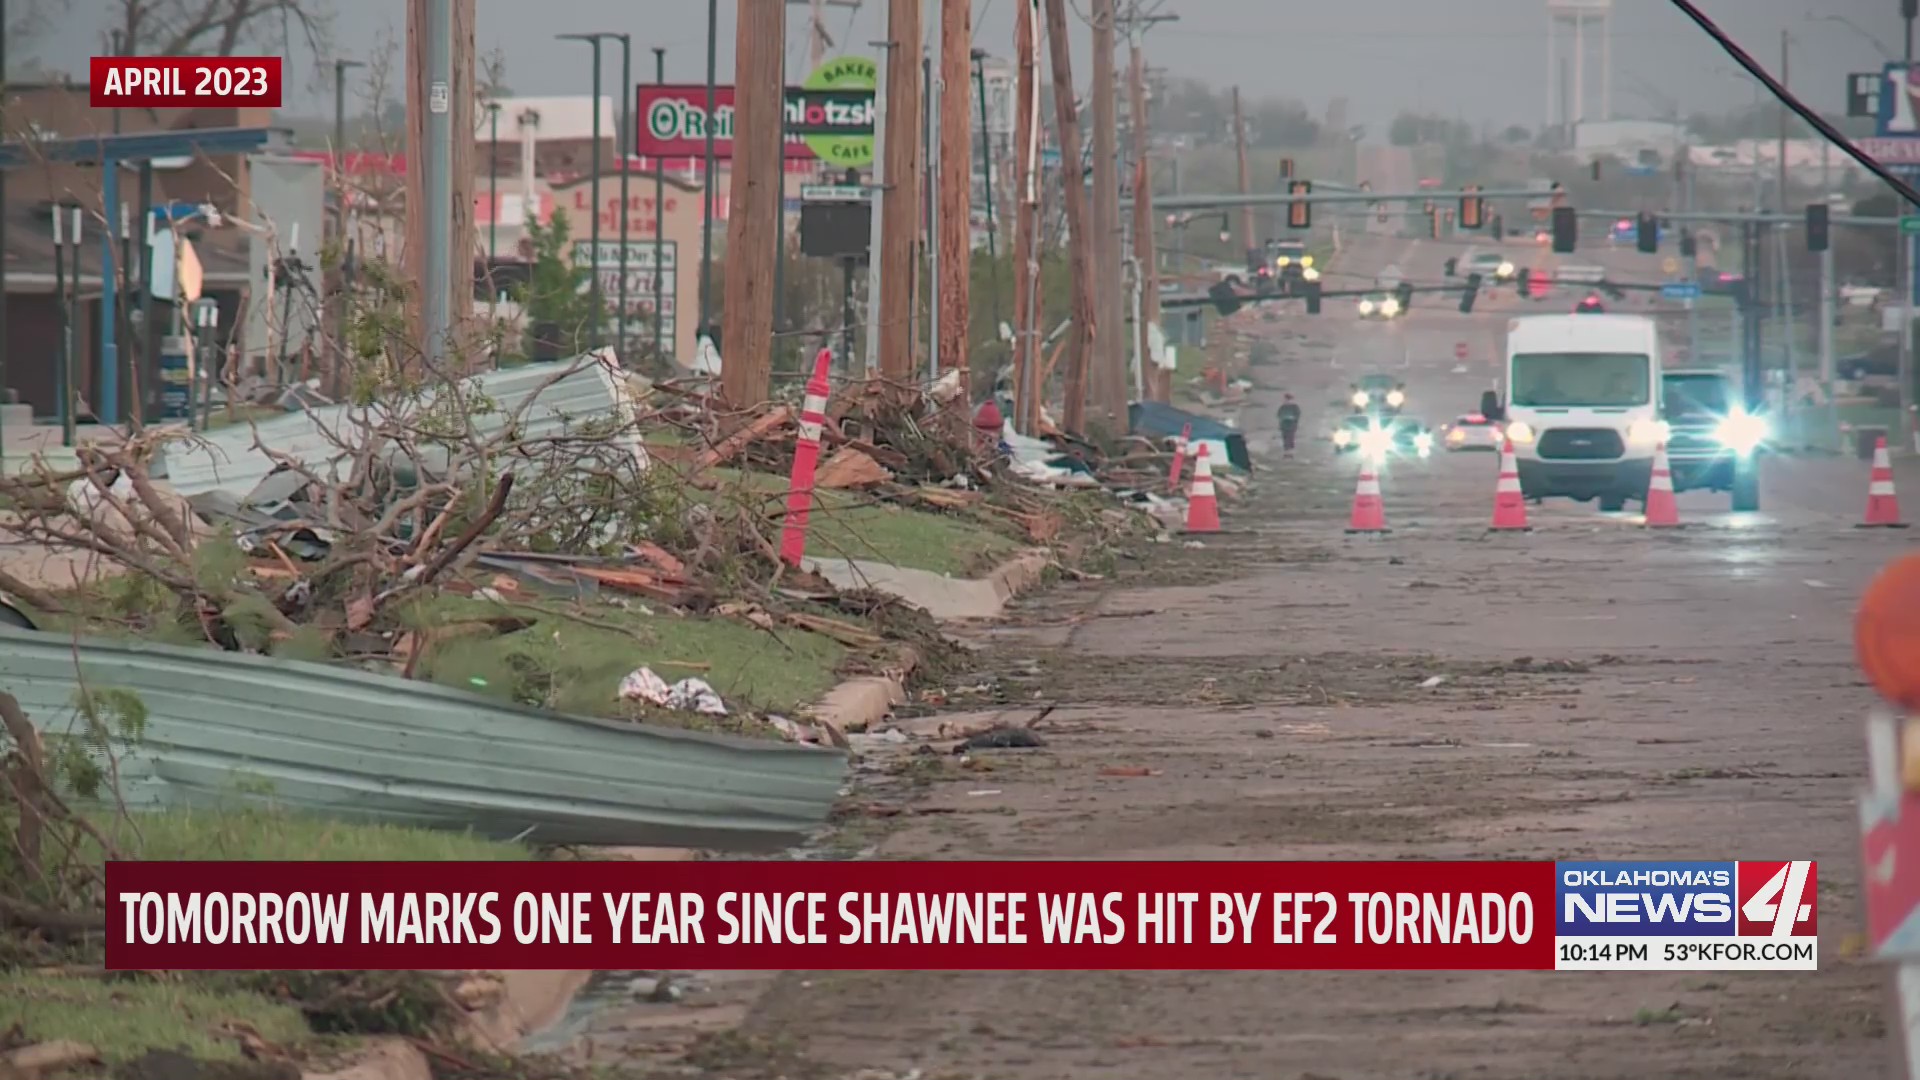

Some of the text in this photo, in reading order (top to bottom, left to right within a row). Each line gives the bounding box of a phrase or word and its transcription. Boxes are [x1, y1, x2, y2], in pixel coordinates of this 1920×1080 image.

[823, 64, 876, 82] BAKER
[649, 97, 735, 140] O'Reil
[784, 97, 875, 125] hlotzsk
